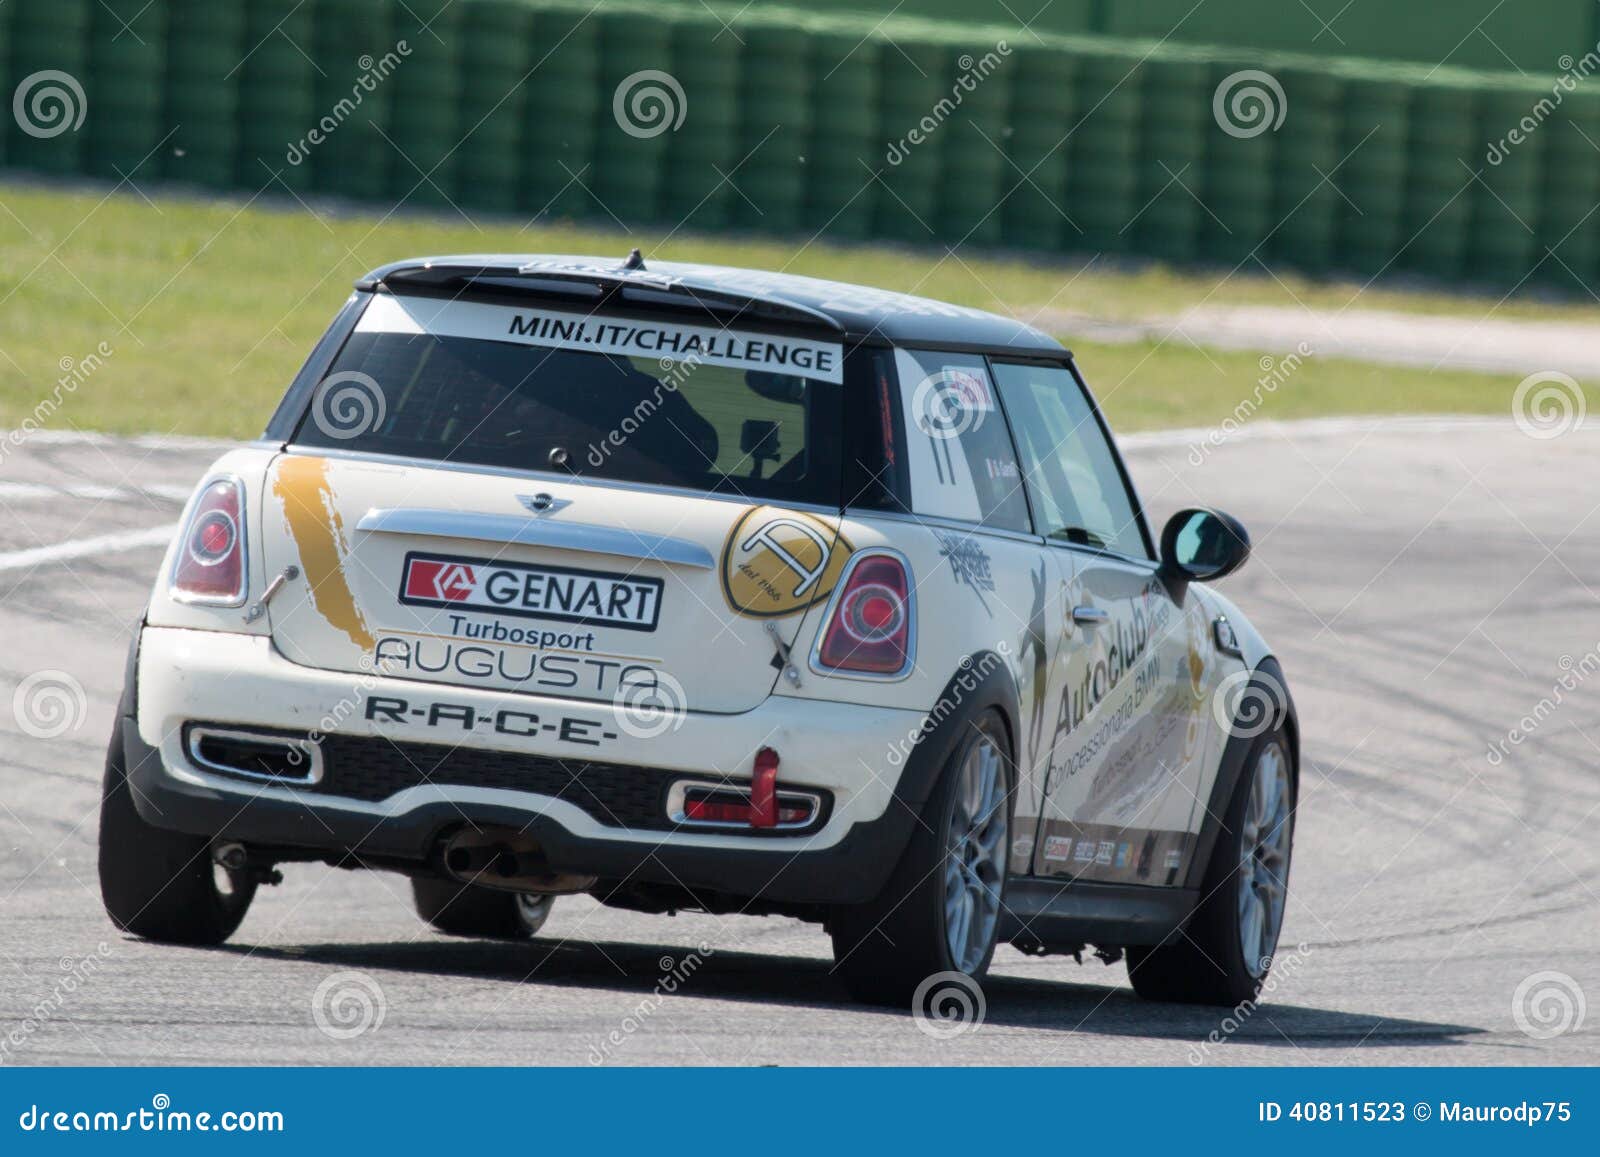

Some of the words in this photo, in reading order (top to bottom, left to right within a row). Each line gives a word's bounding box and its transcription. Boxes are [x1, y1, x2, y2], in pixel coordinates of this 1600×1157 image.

[508, 314, 834, 373] MINI.IT/CHALLENGE
[484, 570, 655, 621] GENART
[449, 614, 594, 651] Turbosport
[374, 637, 659, 697] AUGUSTA
[1054, 596, 1147, 737] Autoclub
[364, 696, 618, 746] R-A-C-E-
